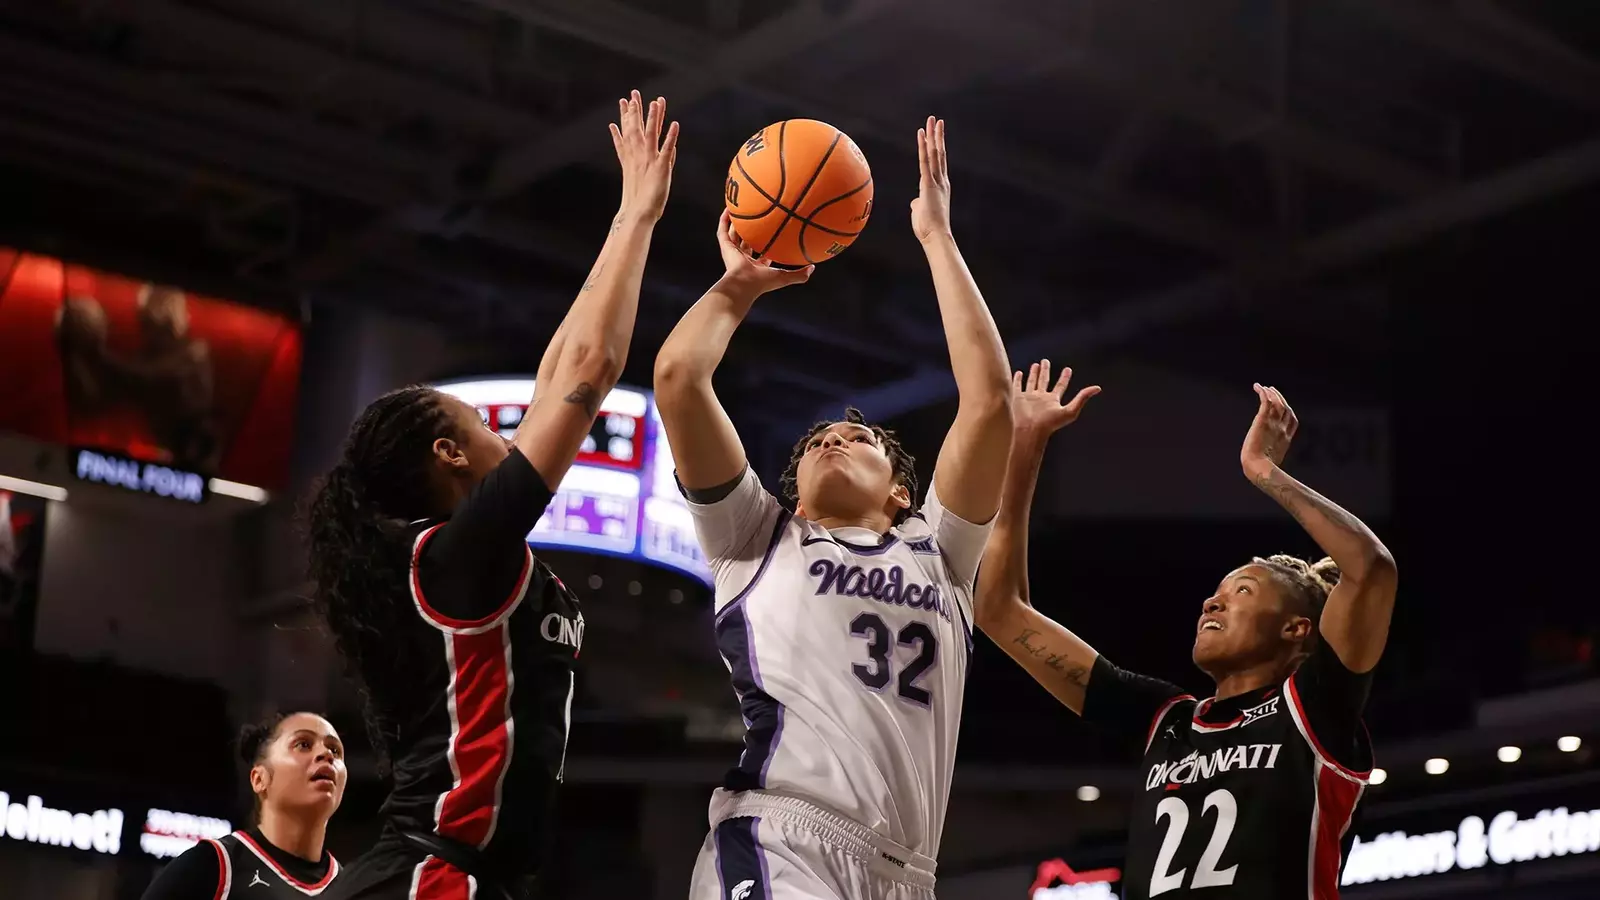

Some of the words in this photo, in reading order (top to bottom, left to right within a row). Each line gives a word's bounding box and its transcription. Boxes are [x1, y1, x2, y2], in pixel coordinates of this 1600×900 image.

[77, 449, 140, 490] FINAL
[142, 463, 204, 503] FOUR
[850, 611, 938, 711] 32
[1149, 788, 1239, 899] 22
